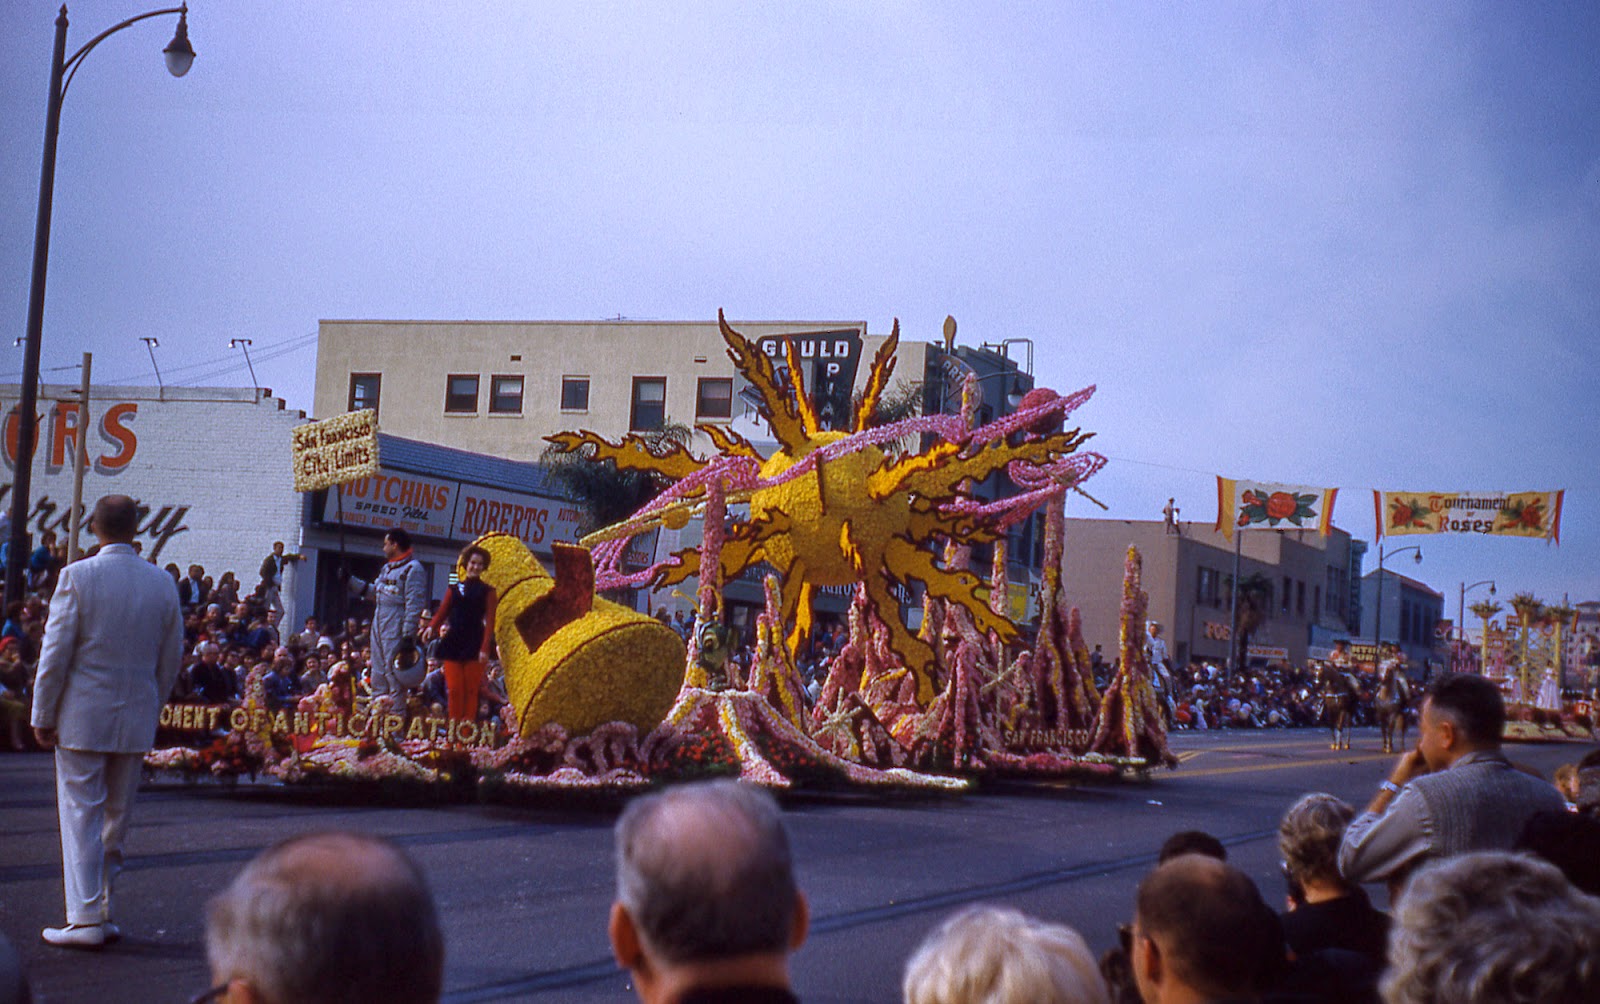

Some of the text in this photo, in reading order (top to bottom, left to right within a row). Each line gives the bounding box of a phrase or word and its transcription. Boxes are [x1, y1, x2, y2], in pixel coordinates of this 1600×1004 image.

[355, 502, 397, 515] SPEED
[1428, 495, 1510, 513] Tournament
[460, 496, 549, 544] ROBERTS
[1439, 515, 1494, 532] Roses
[159, 703, 497, 747] OMENT OF ANTICIPATION
[1029, 729, 1089, 746] FRANCISCO
